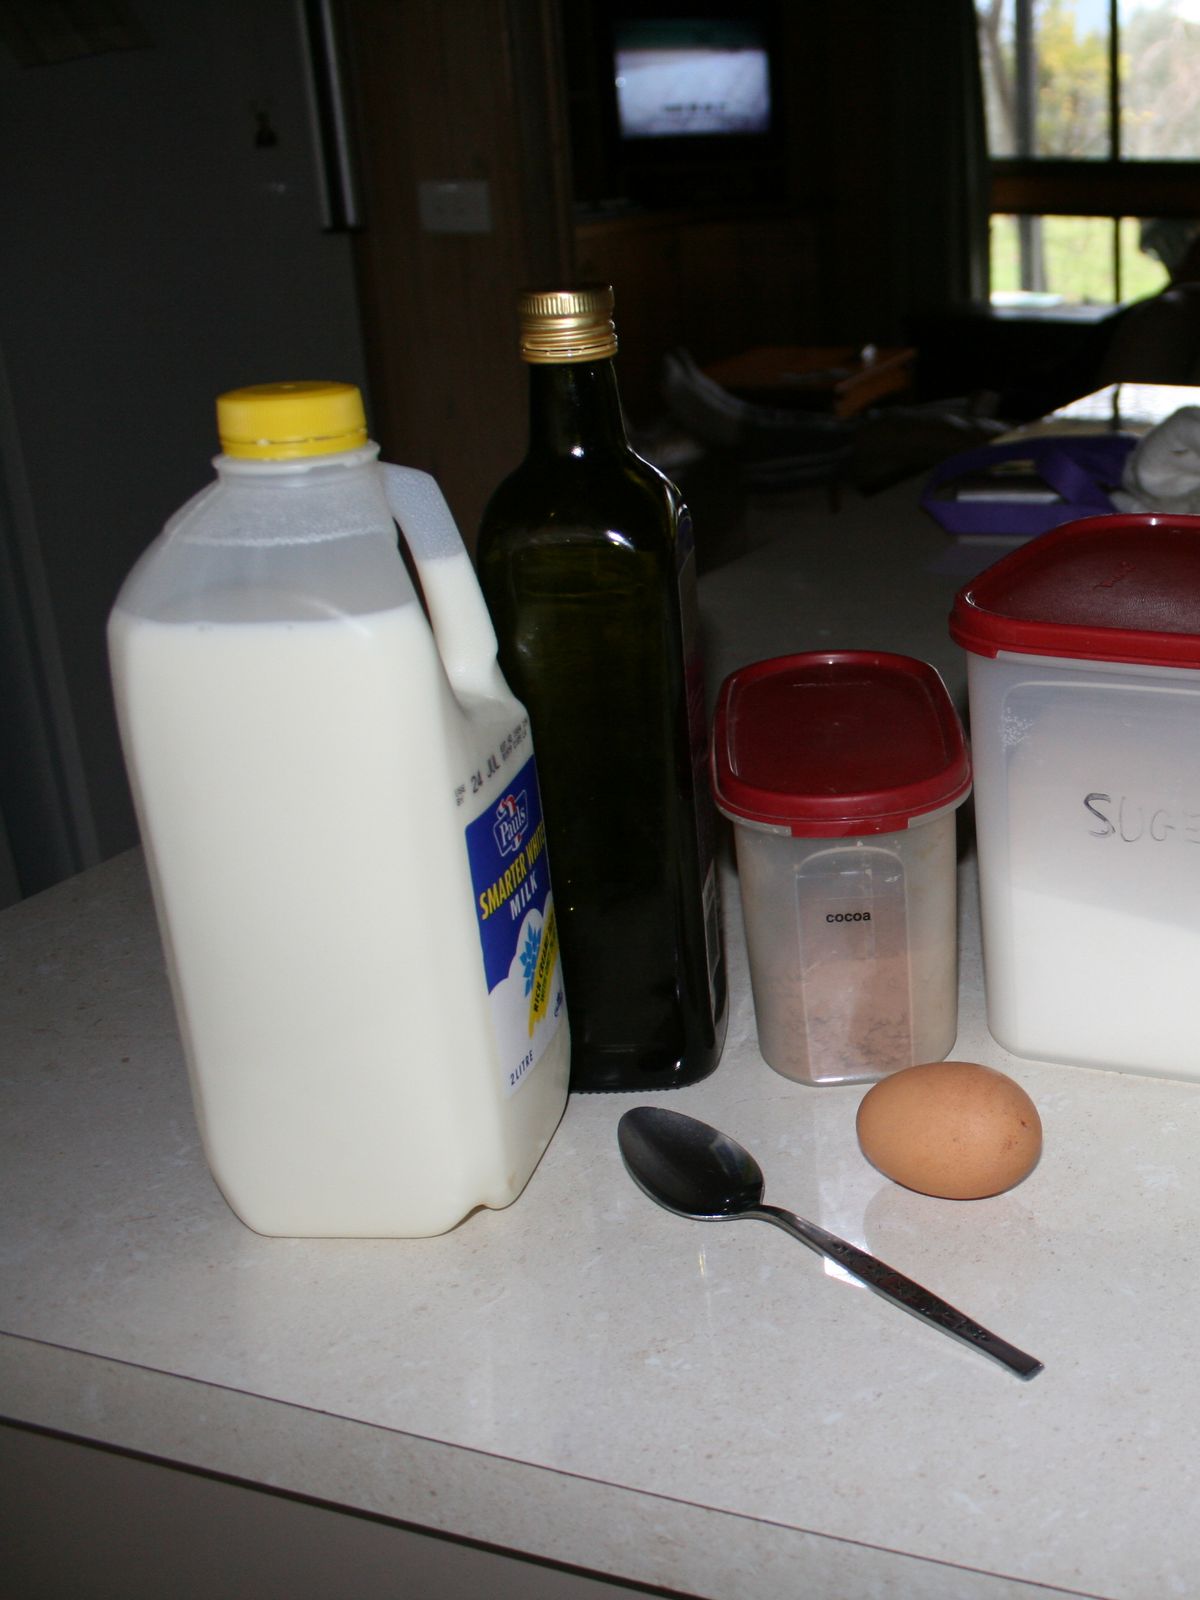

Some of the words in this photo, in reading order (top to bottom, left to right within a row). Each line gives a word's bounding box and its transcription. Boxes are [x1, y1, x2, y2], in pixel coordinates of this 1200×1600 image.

[499, 807, 526, 846] Pauls
[480, 851, 527, 920] SMARTER
[510, 870, 537, 920] MILK
[826, 911, 871, 923] cocoa
